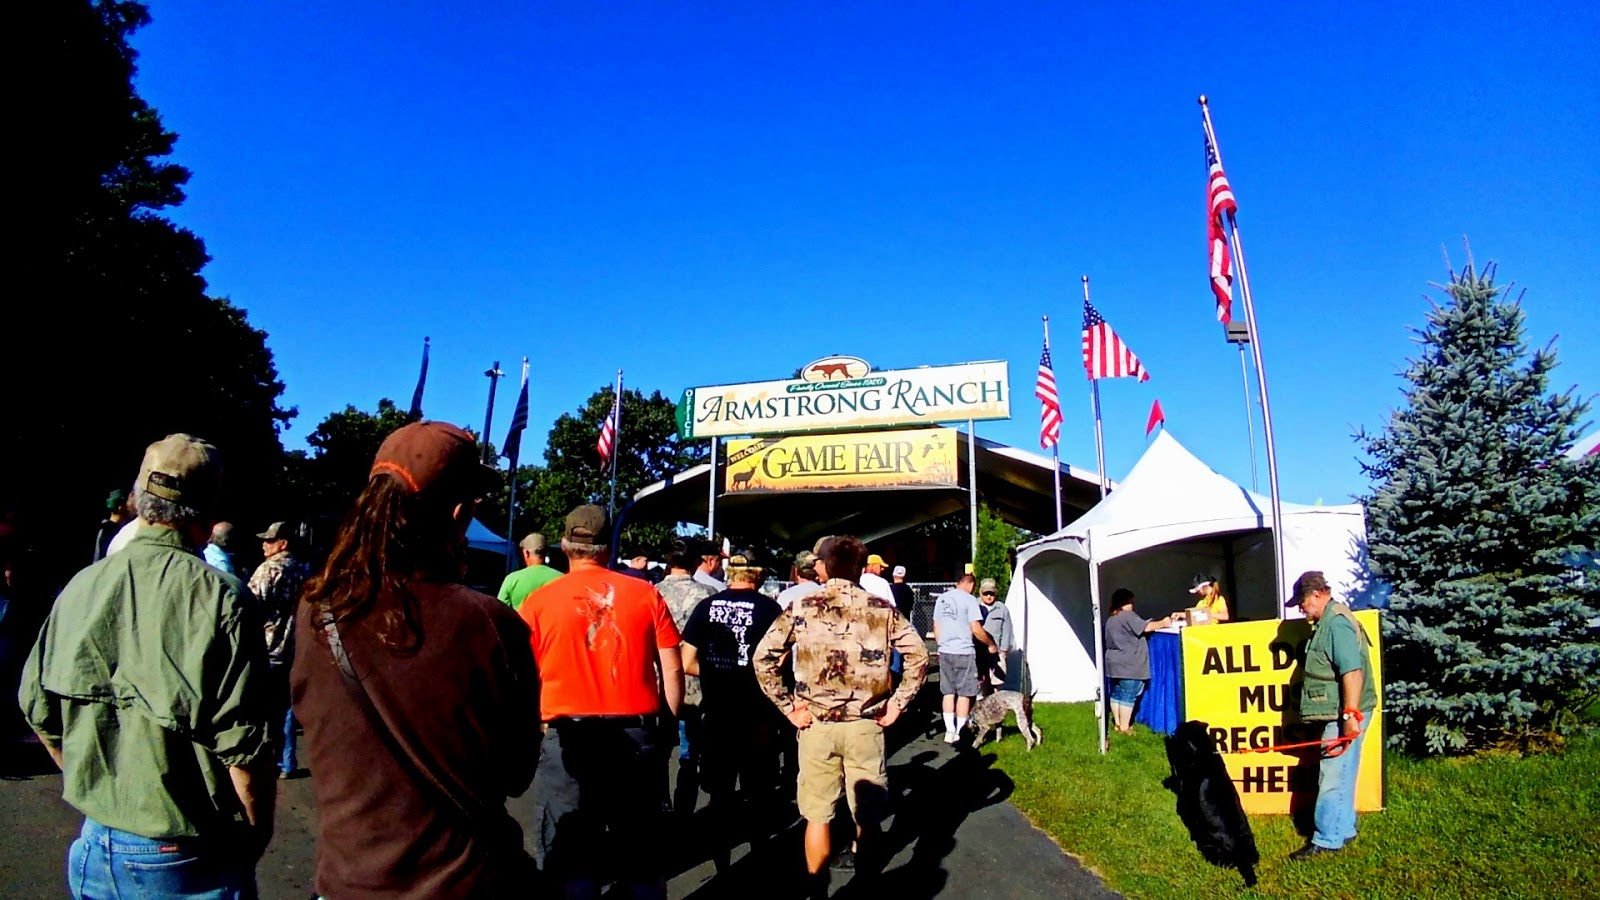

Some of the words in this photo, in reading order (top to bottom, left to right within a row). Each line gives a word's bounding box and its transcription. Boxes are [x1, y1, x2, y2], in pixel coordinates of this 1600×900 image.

[697, 389, 881, 423] ARMSTRONG
[888, 378, 1003, 416] RANCH
[814, 382, 840, 391] Owned
[684, 389, 694, 437] OFFICE
[730, 442, 766, 463] WELCOME
[762, 444, 846, 479] GAME
[852, 441, 918, 474] FAIR
[1202, 645, 1260, 675] ALL
